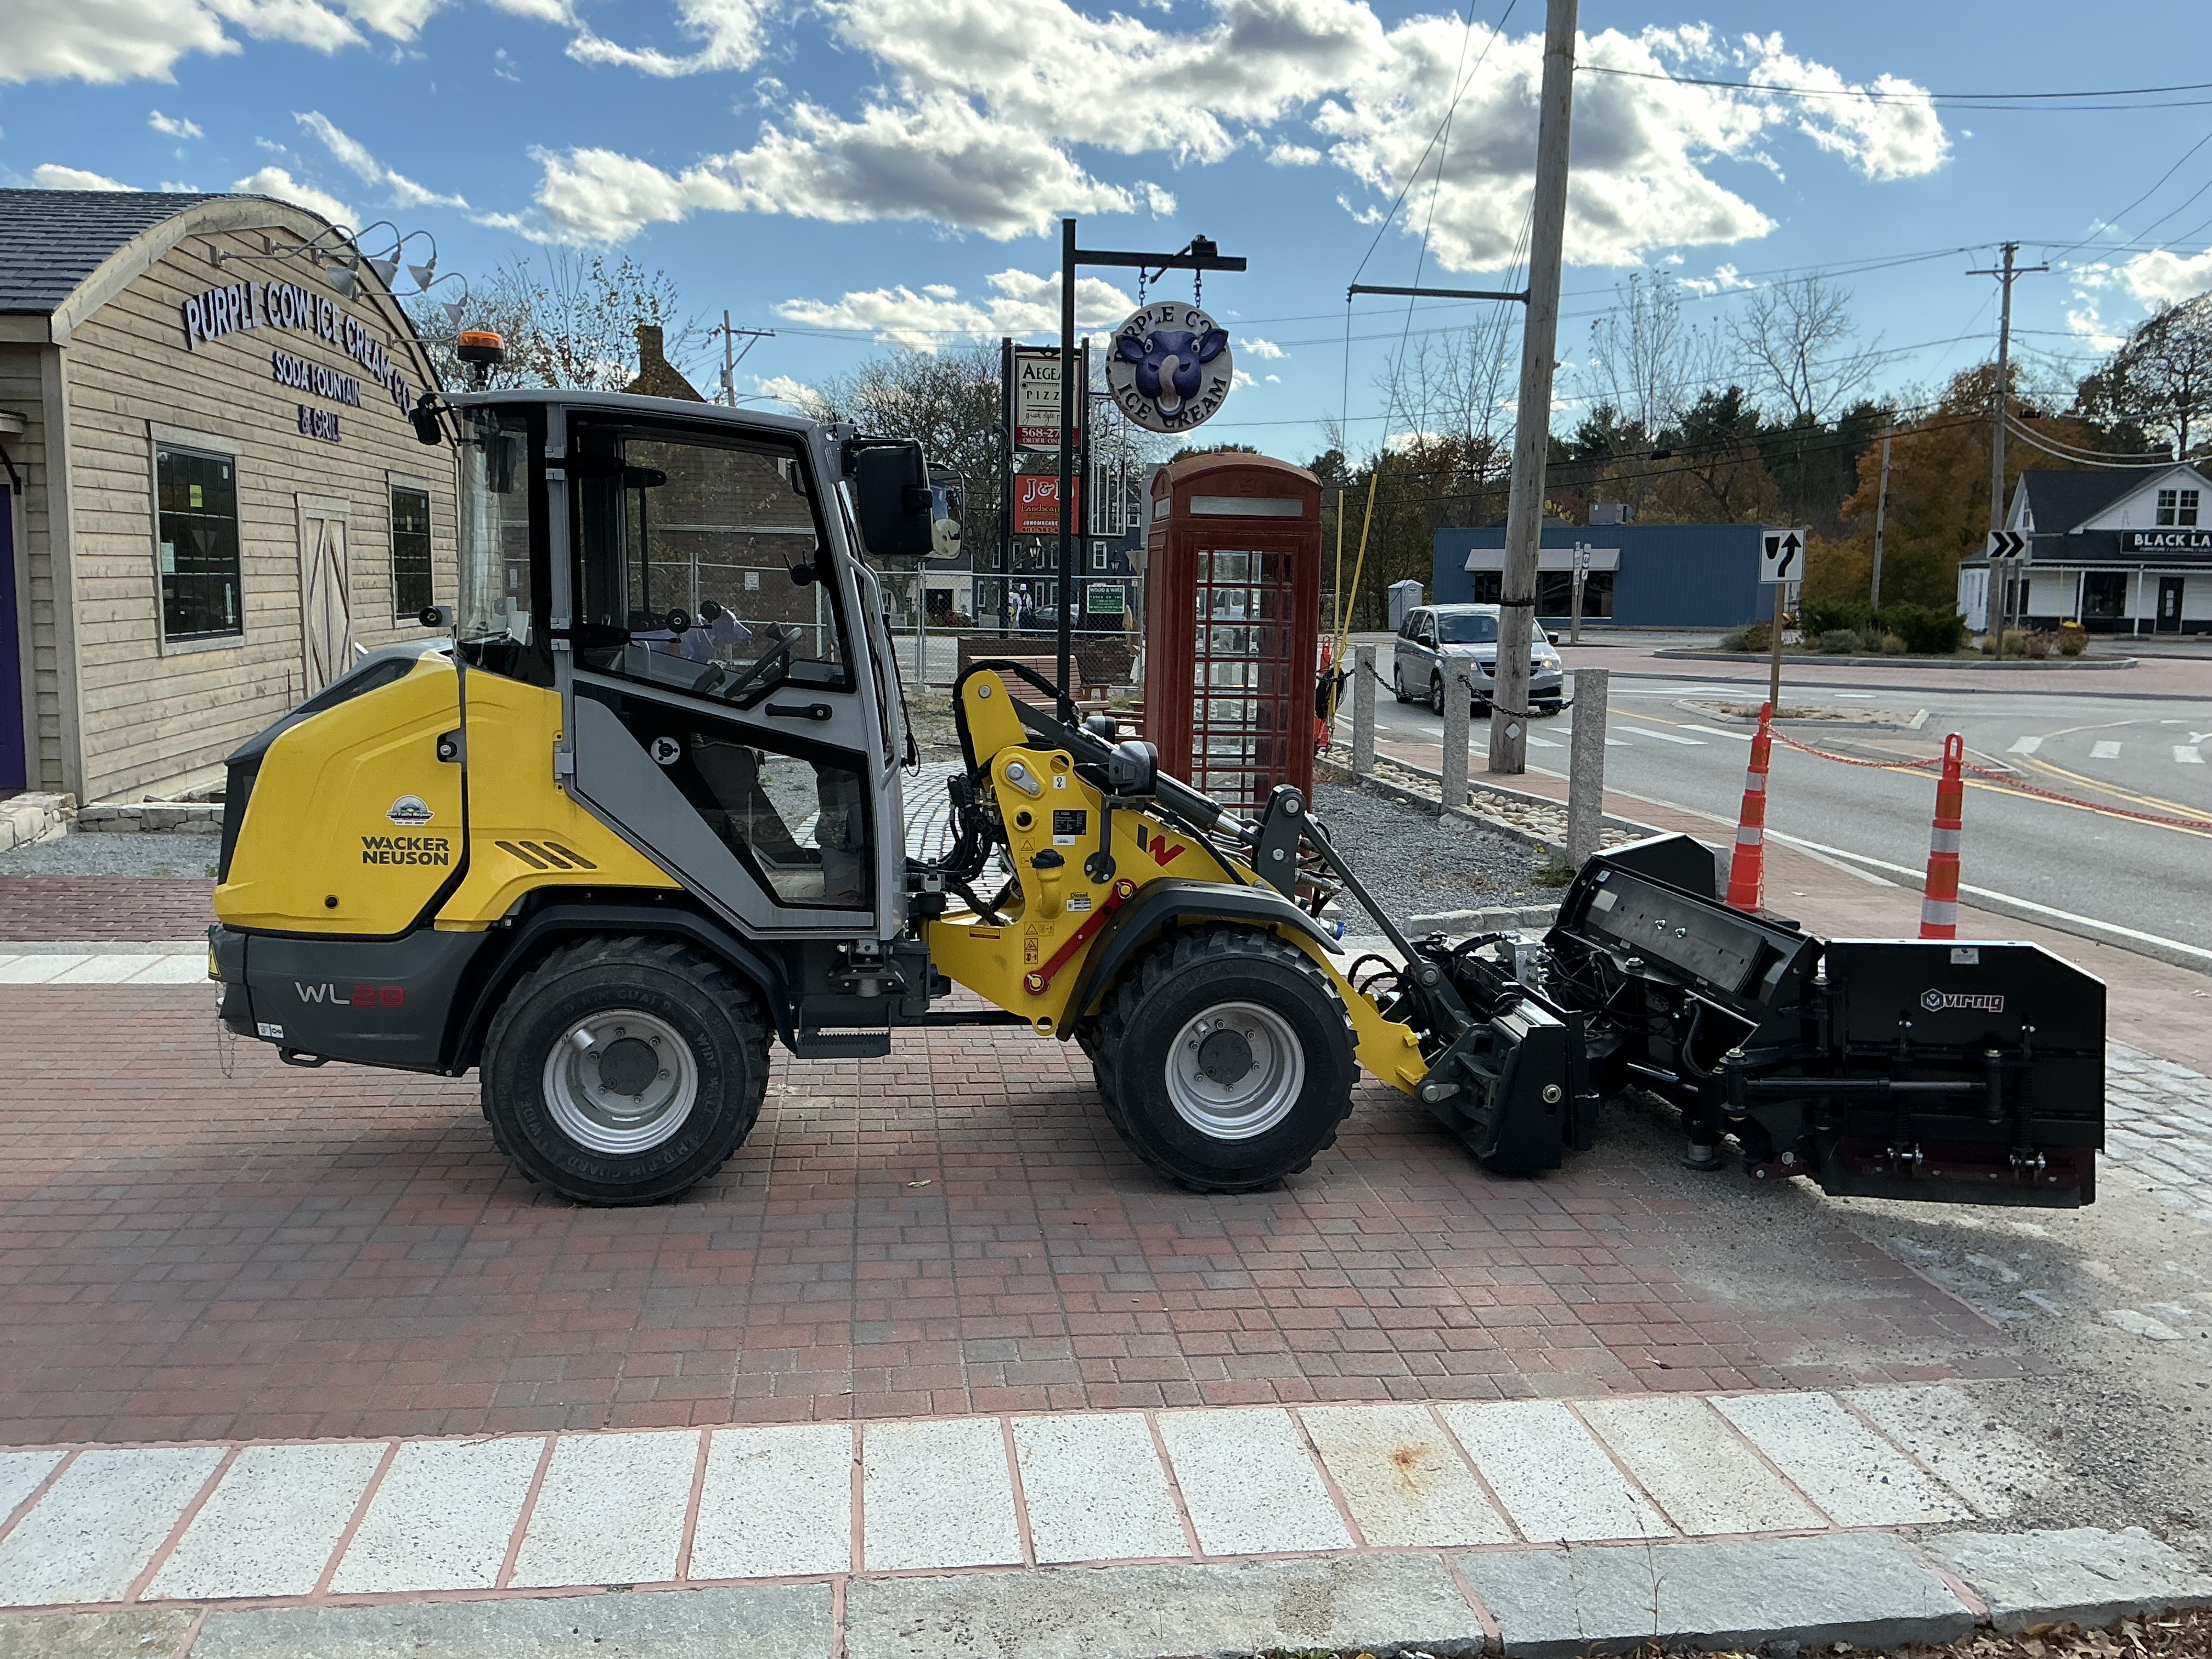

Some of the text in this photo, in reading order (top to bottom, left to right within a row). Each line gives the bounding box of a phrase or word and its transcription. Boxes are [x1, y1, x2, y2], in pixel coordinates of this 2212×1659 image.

[183, 281, 262, 351] PURPLE
[265, 281, 311, 331] COW
[314, 294, 342, 345] ICE
[343, 315, 392, 390] CREAM
[1114, 306, 1174, 362] PRPLE
[273, 351, 362, 408] SODA FOUNTAIN
[1023, 362, 1060, 380] AEGE
[1117, 383, 1152, 421] ICE
[299, 404, 342, 443] & GRILL
[2134, 534, 2186, 546] BLACK
[360, 836, 450, 851] WACKER
[363, 851, 449, 866] NEUSON
[294, 981, 405, 1008] WL28
